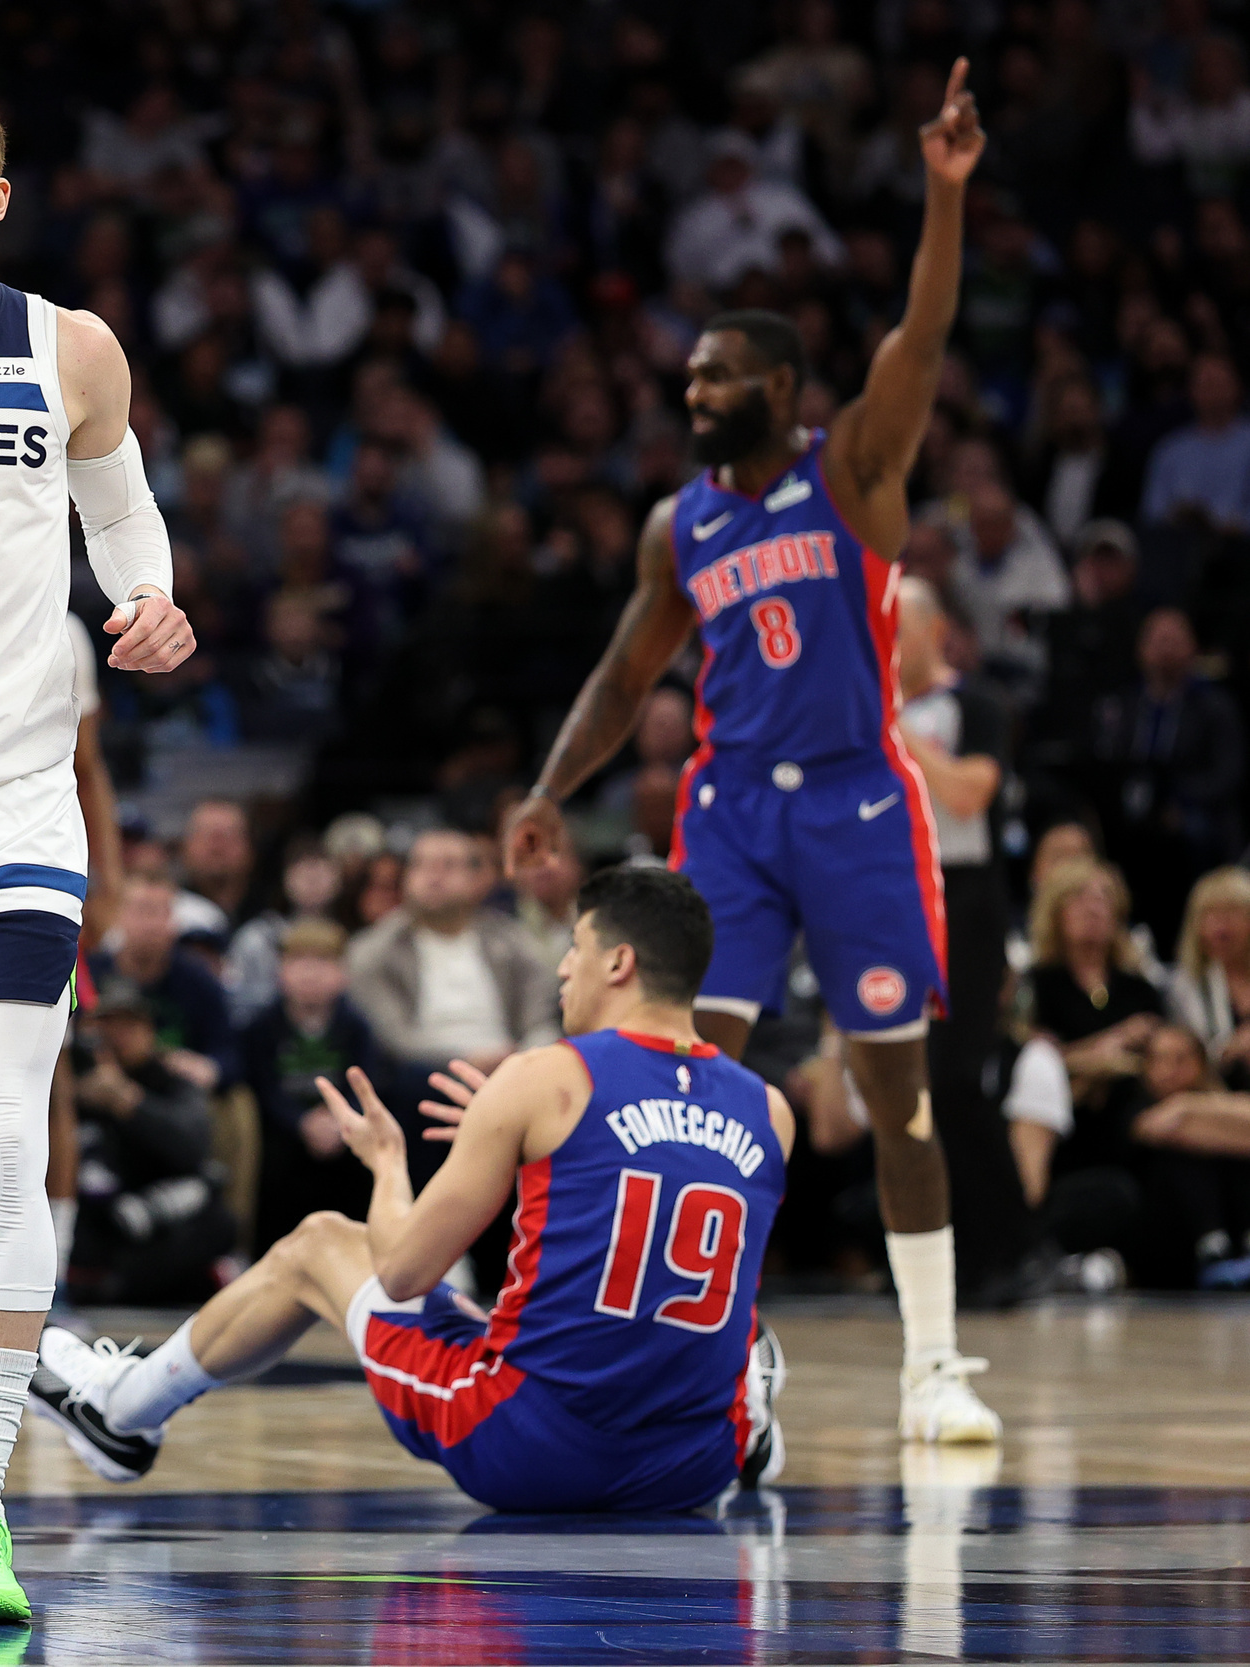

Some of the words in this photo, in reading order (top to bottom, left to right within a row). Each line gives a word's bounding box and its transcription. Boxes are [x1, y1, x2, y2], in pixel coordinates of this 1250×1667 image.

[687, 530, 839, 622] DETROIT
[750, 595, 802, 669] 8
[605, 1098, 766, 1178] FONTECCHIO
[594, 1167, 748, 1334] 19
